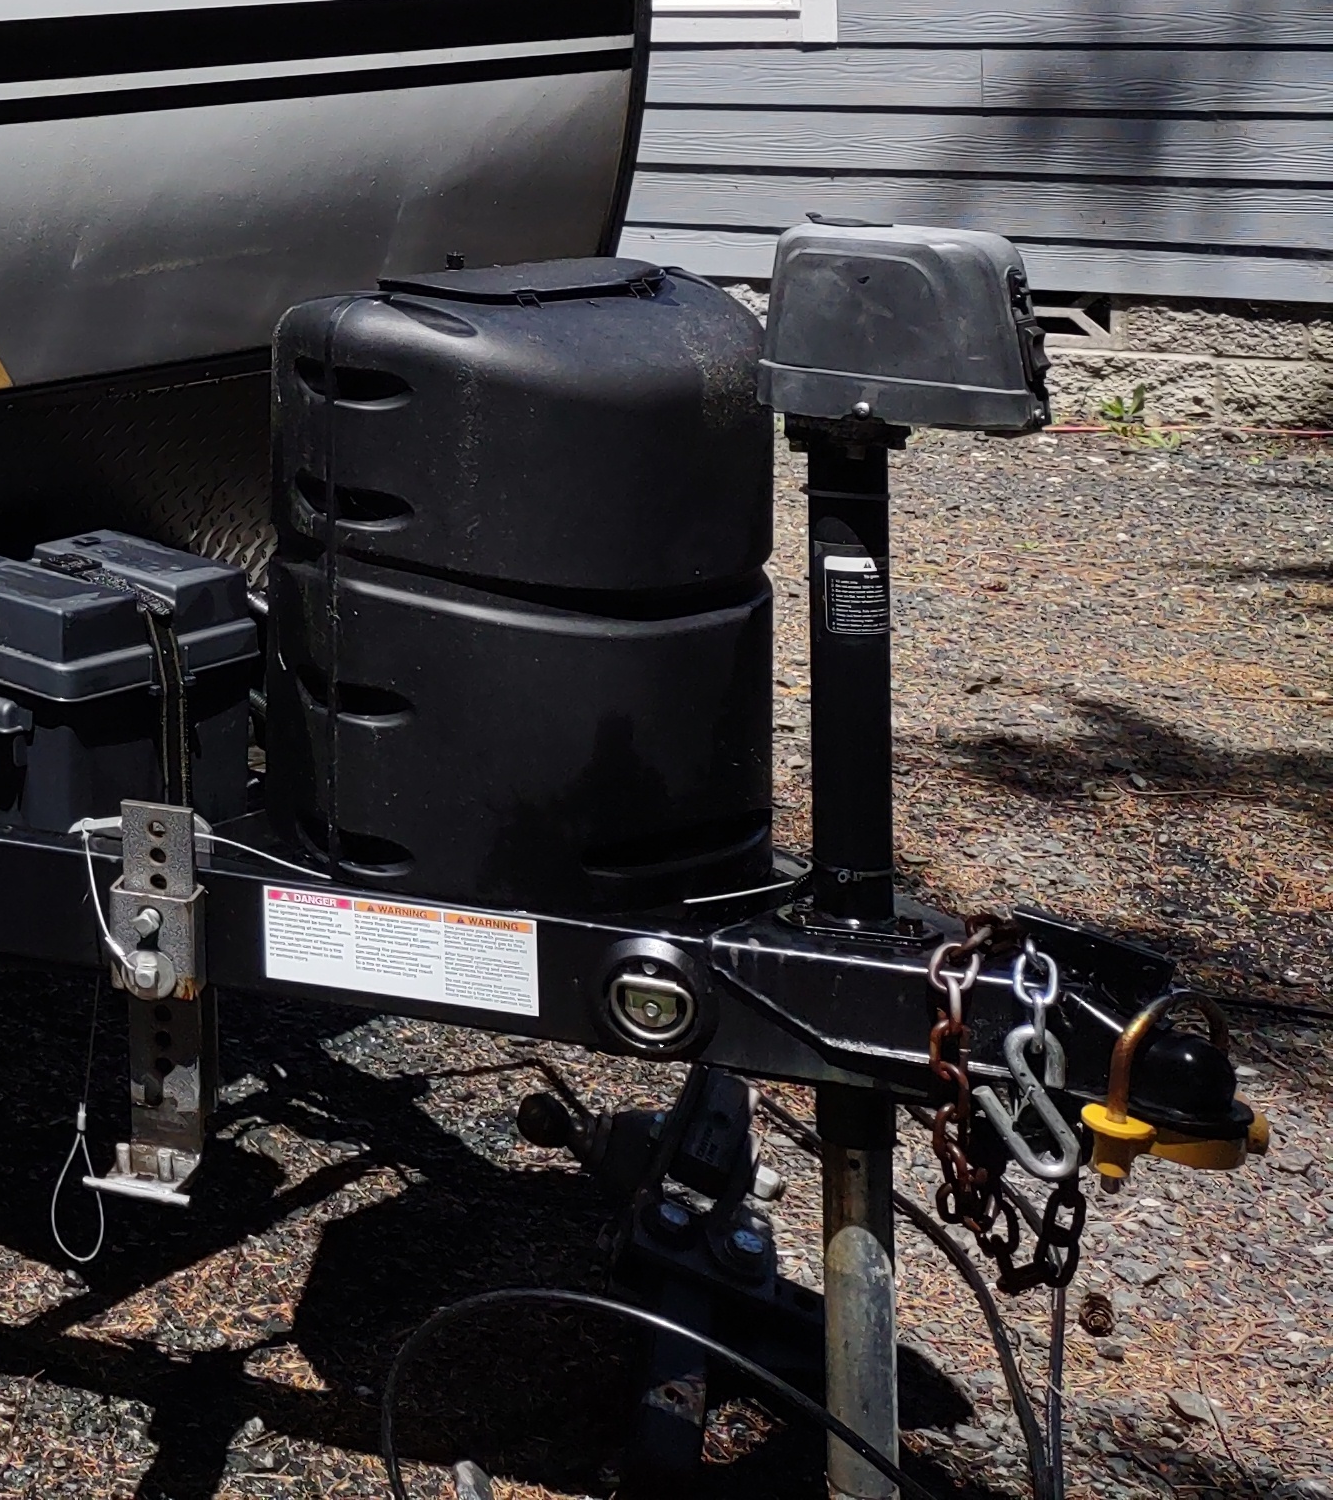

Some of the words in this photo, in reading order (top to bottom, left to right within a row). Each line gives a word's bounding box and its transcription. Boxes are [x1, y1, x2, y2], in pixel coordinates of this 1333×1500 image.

[293, 893, 338, 907] DANGER
[377, 905, 428, 919] WARNING
[468, 916, 519, 931] WARNING
